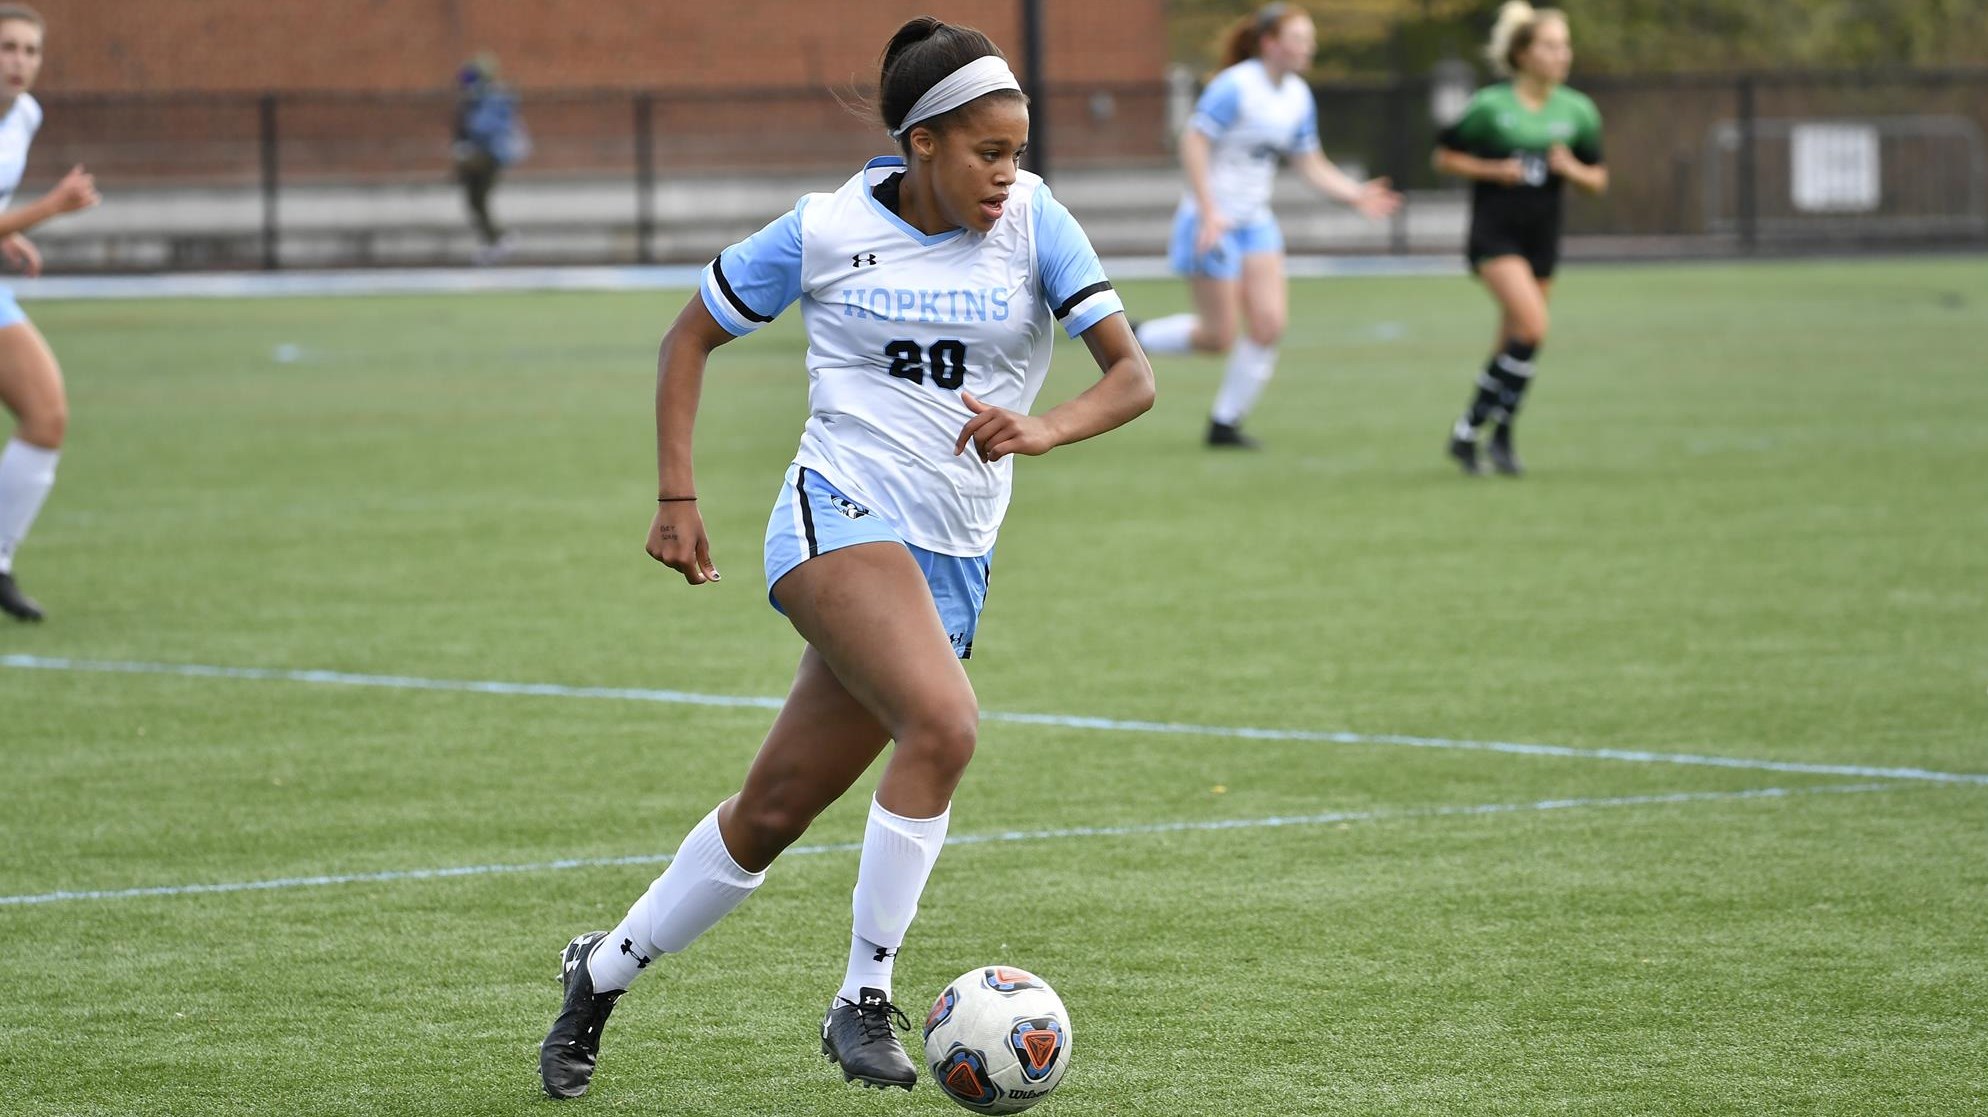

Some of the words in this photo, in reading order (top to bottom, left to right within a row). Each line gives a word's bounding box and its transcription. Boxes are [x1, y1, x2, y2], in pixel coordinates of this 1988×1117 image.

[843, 287, 1009, 322] HOPKINS
[885, 339, 966, 390] 20
[1008, 1089, 1049, 1099] Wilson
